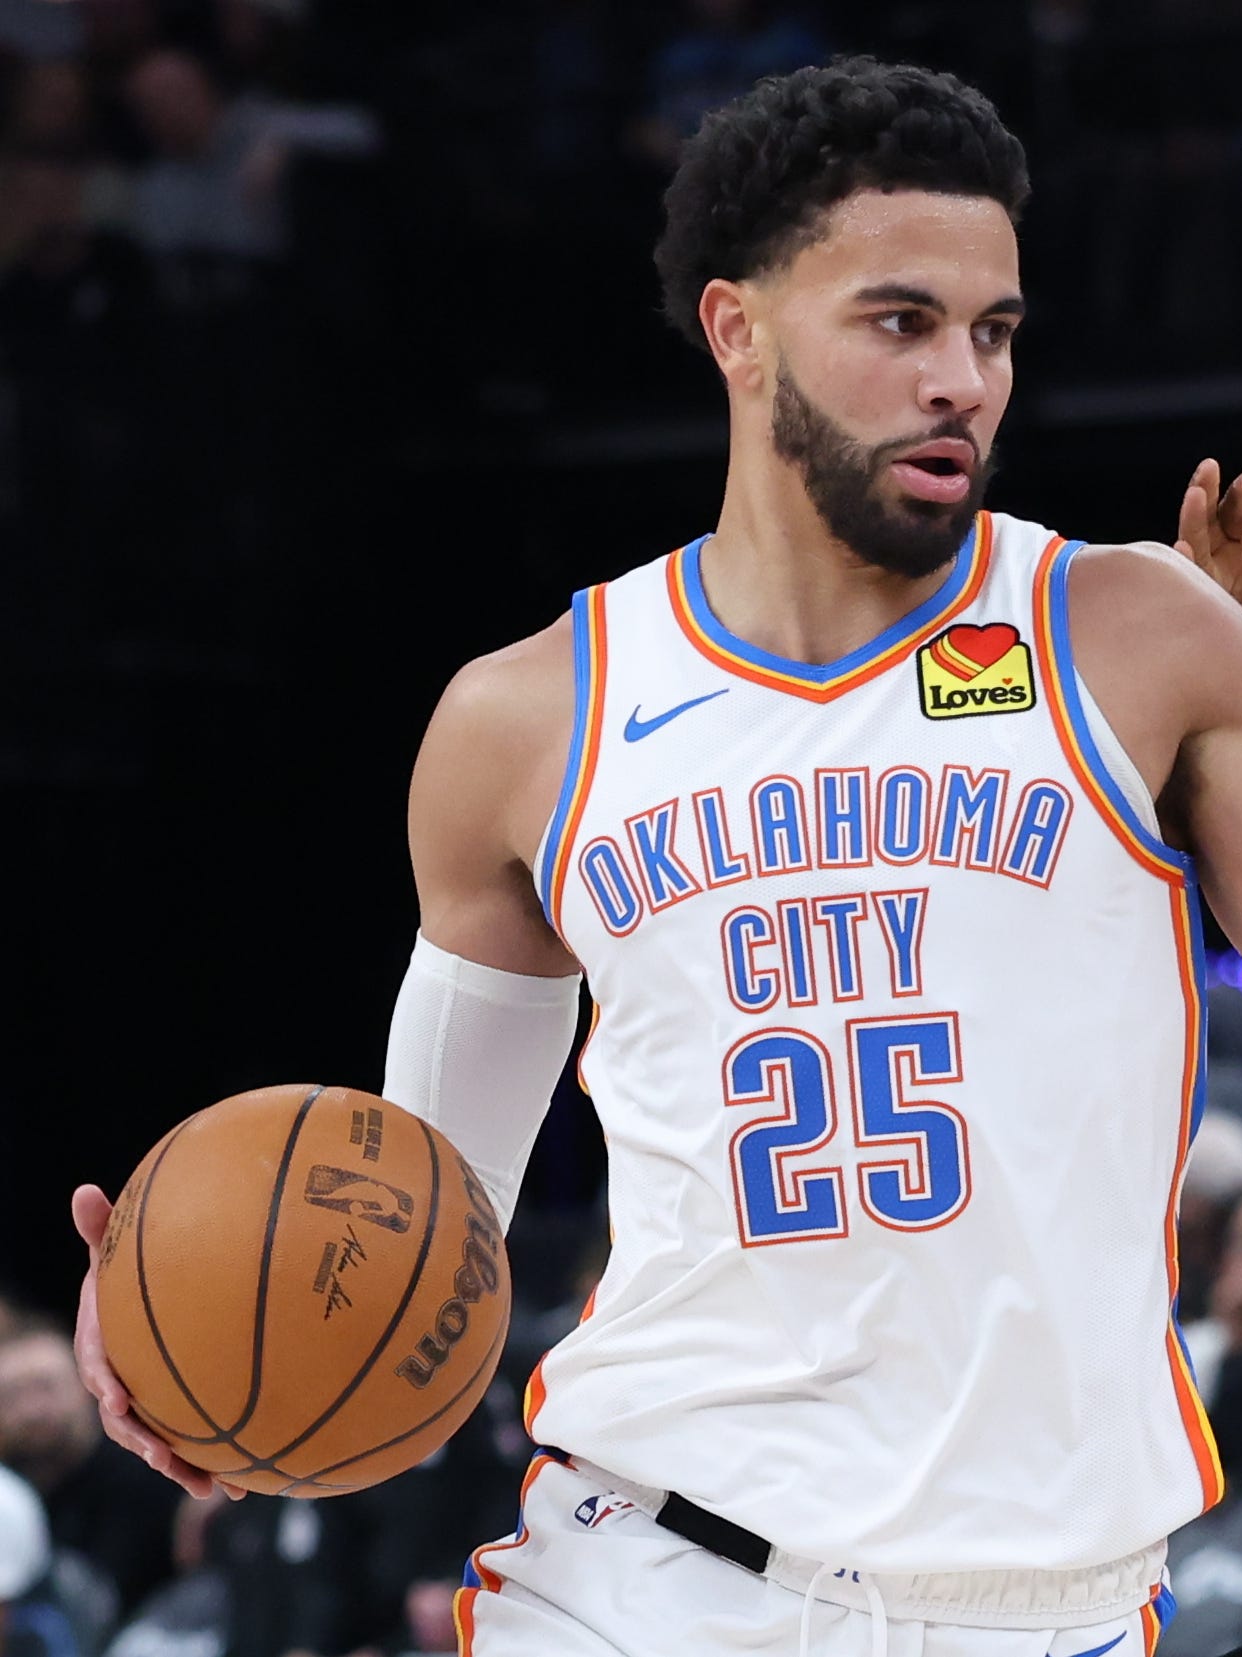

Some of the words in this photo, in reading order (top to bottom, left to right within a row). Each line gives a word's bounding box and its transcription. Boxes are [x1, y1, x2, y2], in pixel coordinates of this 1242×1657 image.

[578, 764, 1074, 938] OKLAHOMA
[720, 887, 929, 1014] CITY
[722, 1011, 971, 1249] 25
